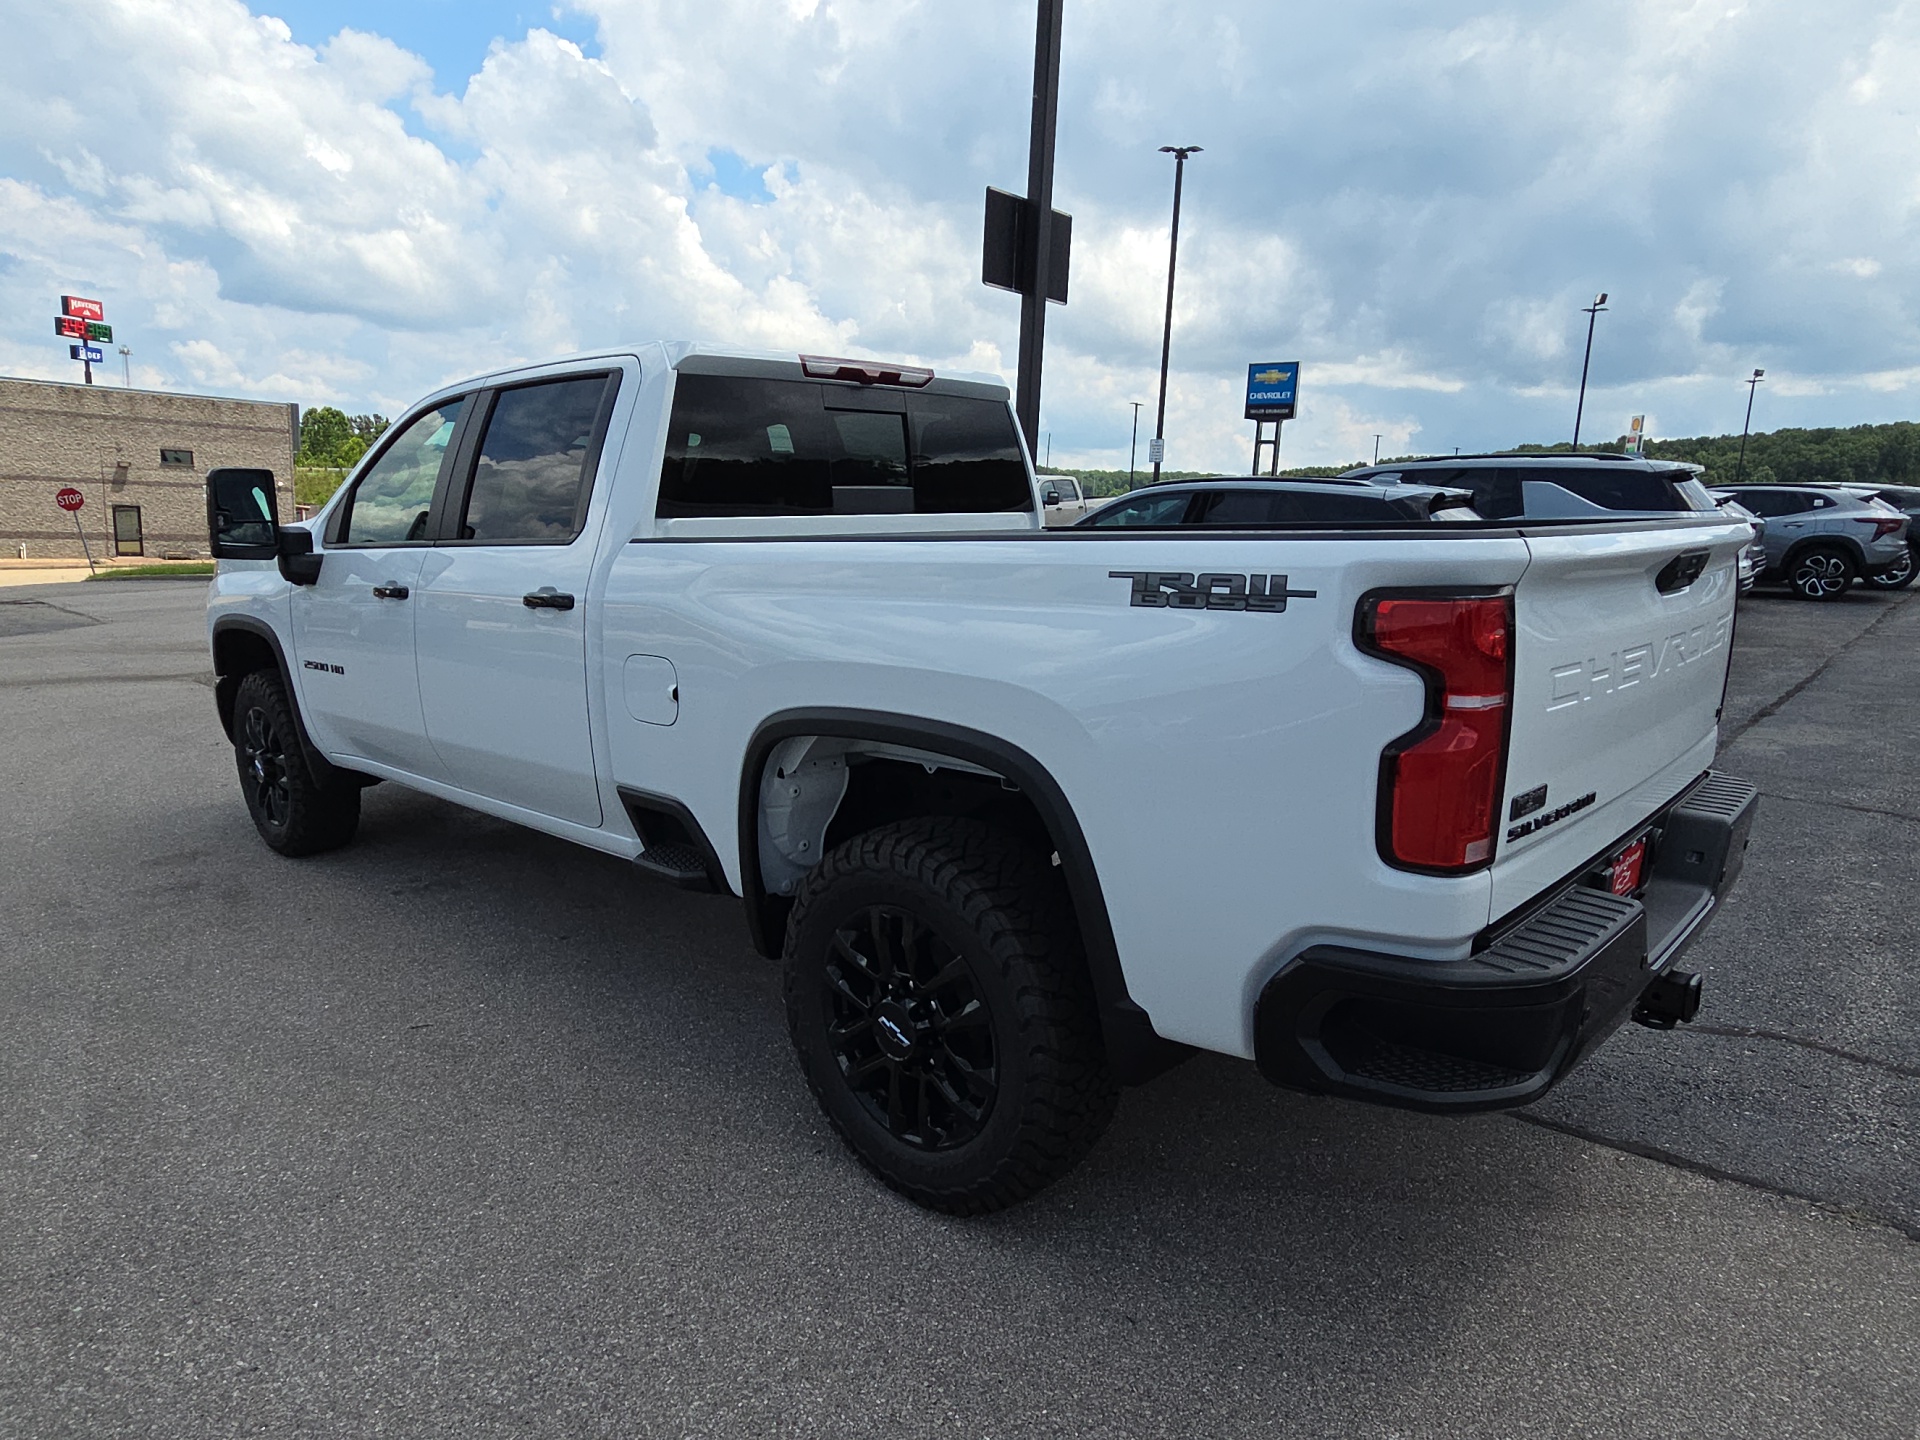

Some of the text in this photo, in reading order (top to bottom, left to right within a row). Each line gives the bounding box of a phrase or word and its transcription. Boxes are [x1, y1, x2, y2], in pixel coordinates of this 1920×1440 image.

[1250, 391, 1291, 400] CHEVROLET
[58, 493, 82, 506] STOP
[1108, 571, 1317, 598] TRAIL
[1130, 590, 1288, 613] BOSS
[303, 660, 345, 675] 2500 HD
[1546, 611, 1733, 713] CHEVROLET
[1506, 790, 1597, 844] SILVERADO
